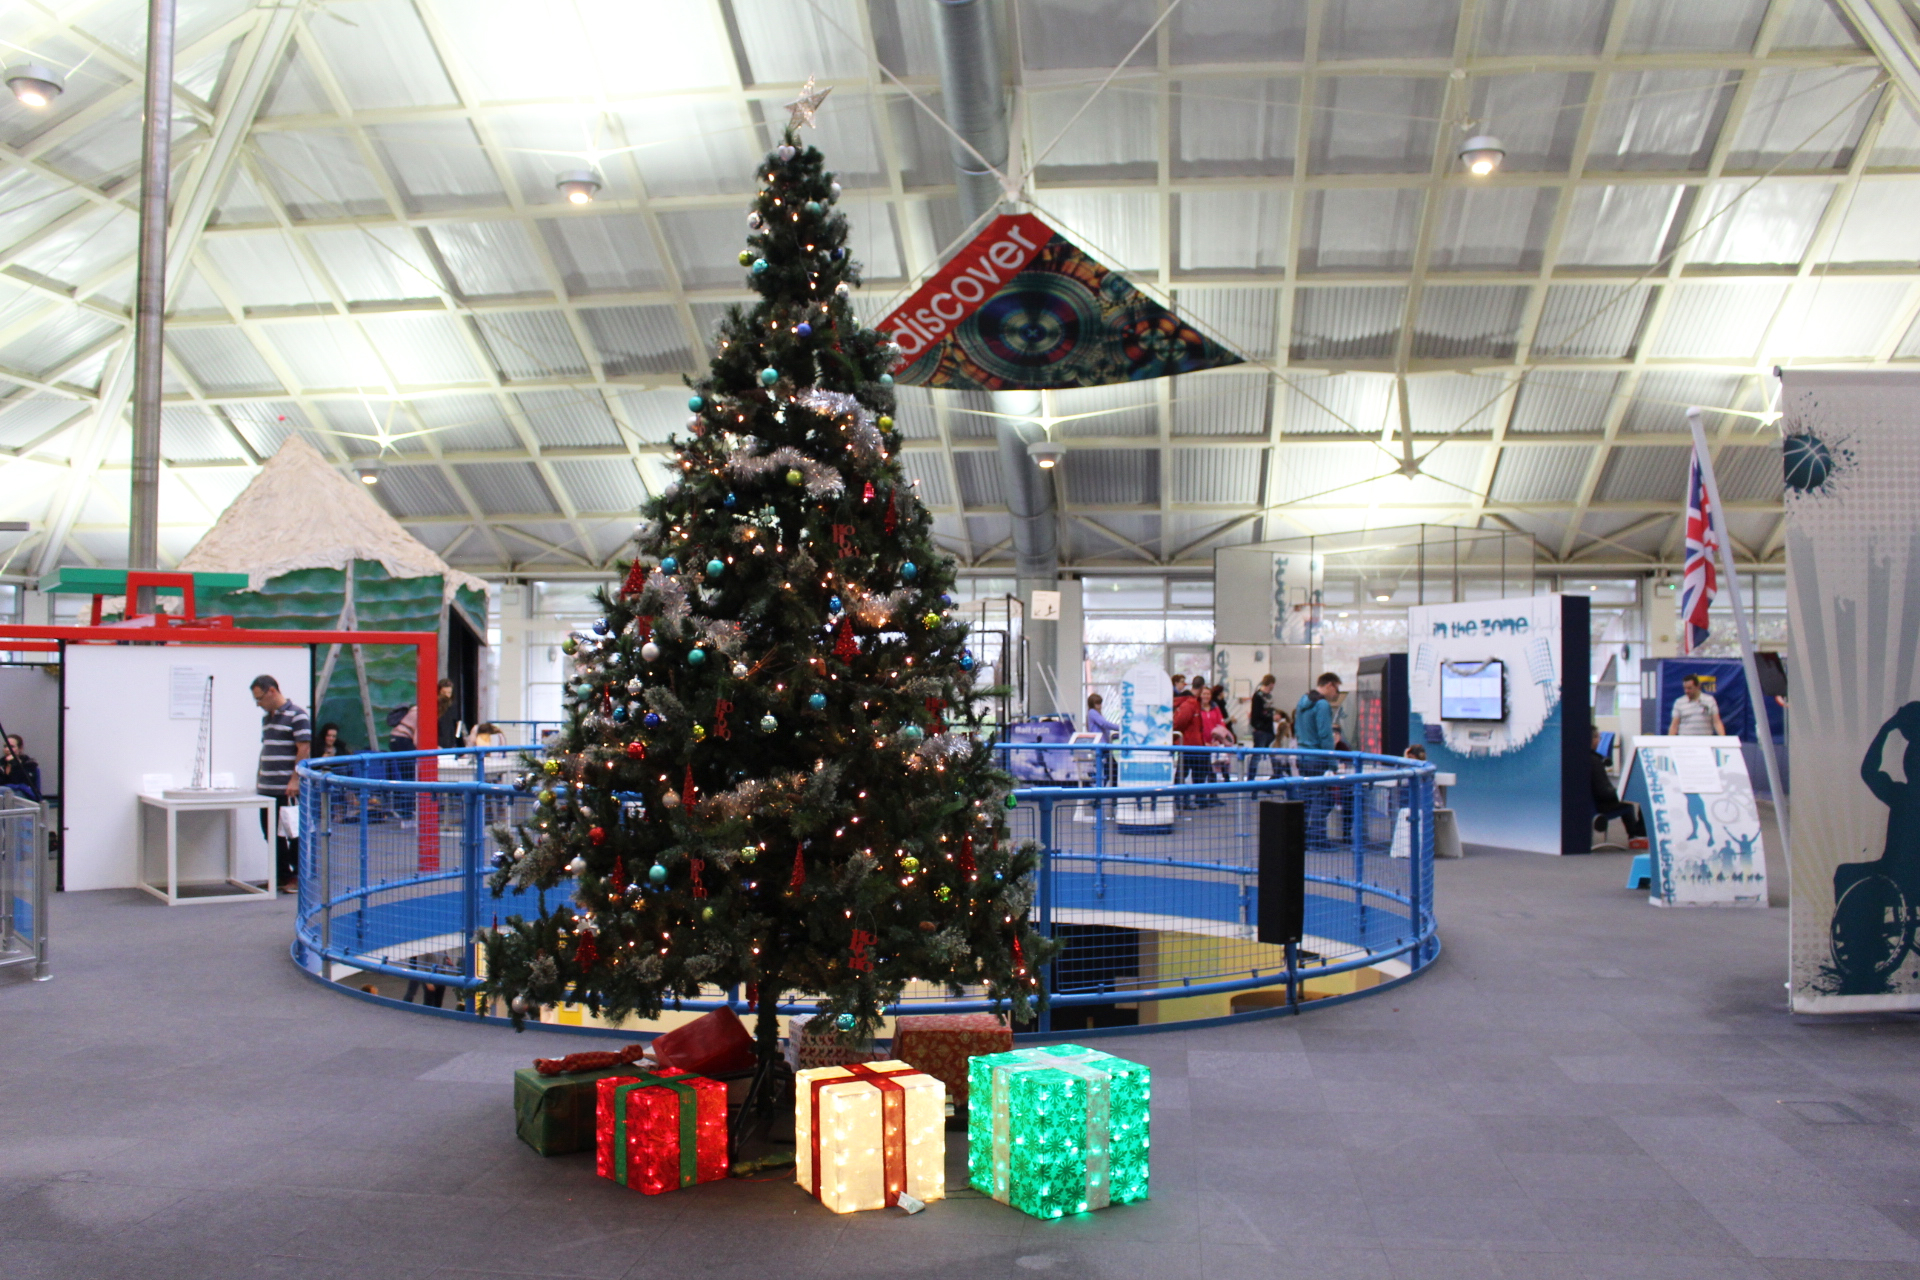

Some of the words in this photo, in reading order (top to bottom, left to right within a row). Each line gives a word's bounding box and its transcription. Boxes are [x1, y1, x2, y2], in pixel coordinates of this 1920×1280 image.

[890, 224, 1037, 355] discover
[1433, 622, 1447, 638] in
[1451, 621, 1478, 638] the
[1480, 616, 1529, 636] zone
[1655, 810, 1671, 834] an
[1660, 839, 1676, 905] design
